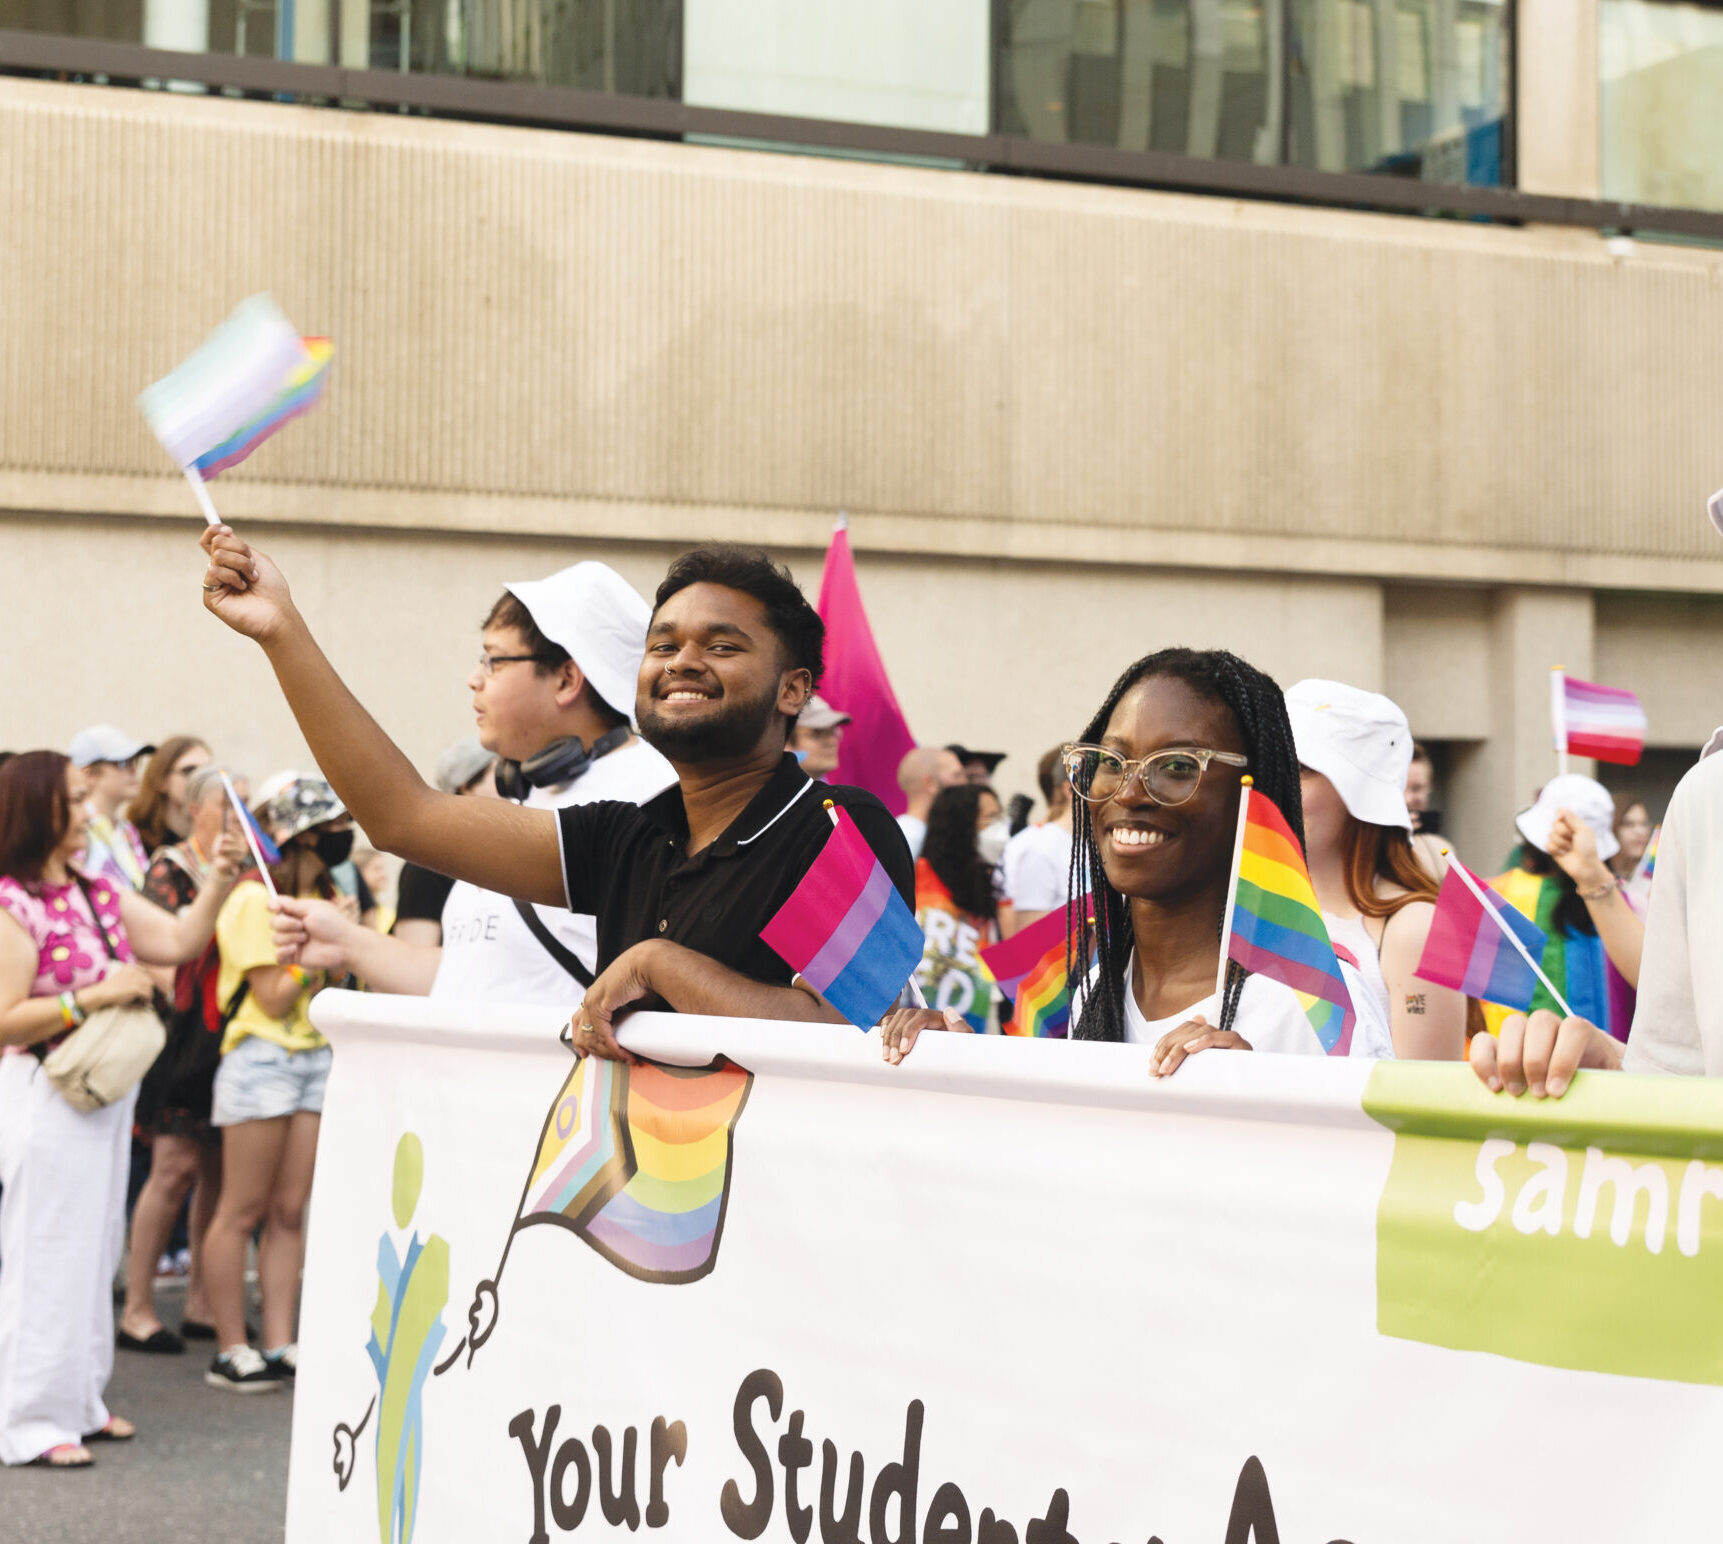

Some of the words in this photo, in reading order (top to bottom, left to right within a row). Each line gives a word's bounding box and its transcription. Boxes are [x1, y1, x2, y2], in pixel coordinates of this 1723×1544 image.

[921, 907, 980, 967] RE
[509, 1405, 687, 1544] Your
[721, 1369, 1165, 1544] Stude
